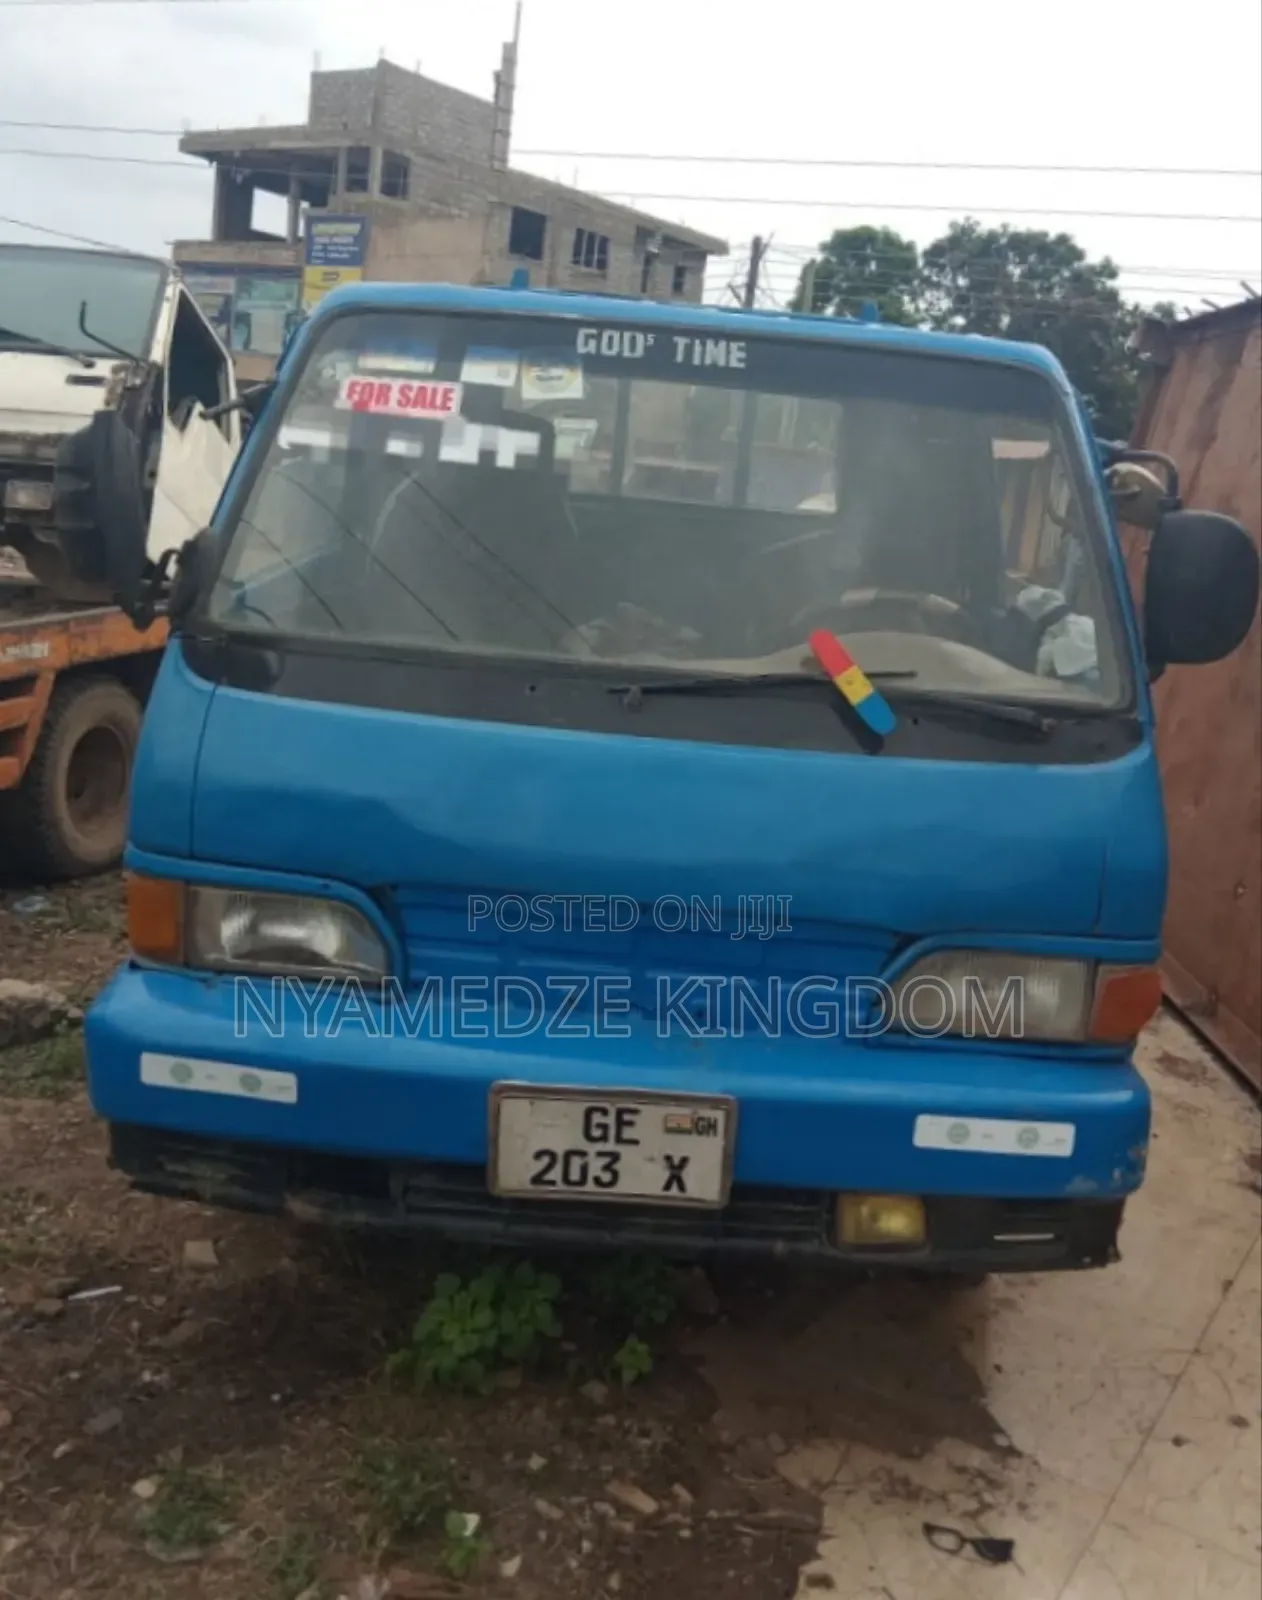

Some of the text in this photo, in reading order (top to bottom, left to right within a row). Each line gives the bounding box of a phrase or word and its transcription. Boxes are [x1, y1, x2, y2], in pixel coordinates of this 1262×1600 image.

[673, 336, 747, 369] TIME
[346, 379, 456, 412] FOR SALE
[583, 1105, 641, 1146] GE
[694, 1115, 718, 1137] GH
[529, 1148, 691, 1193] 203 X
